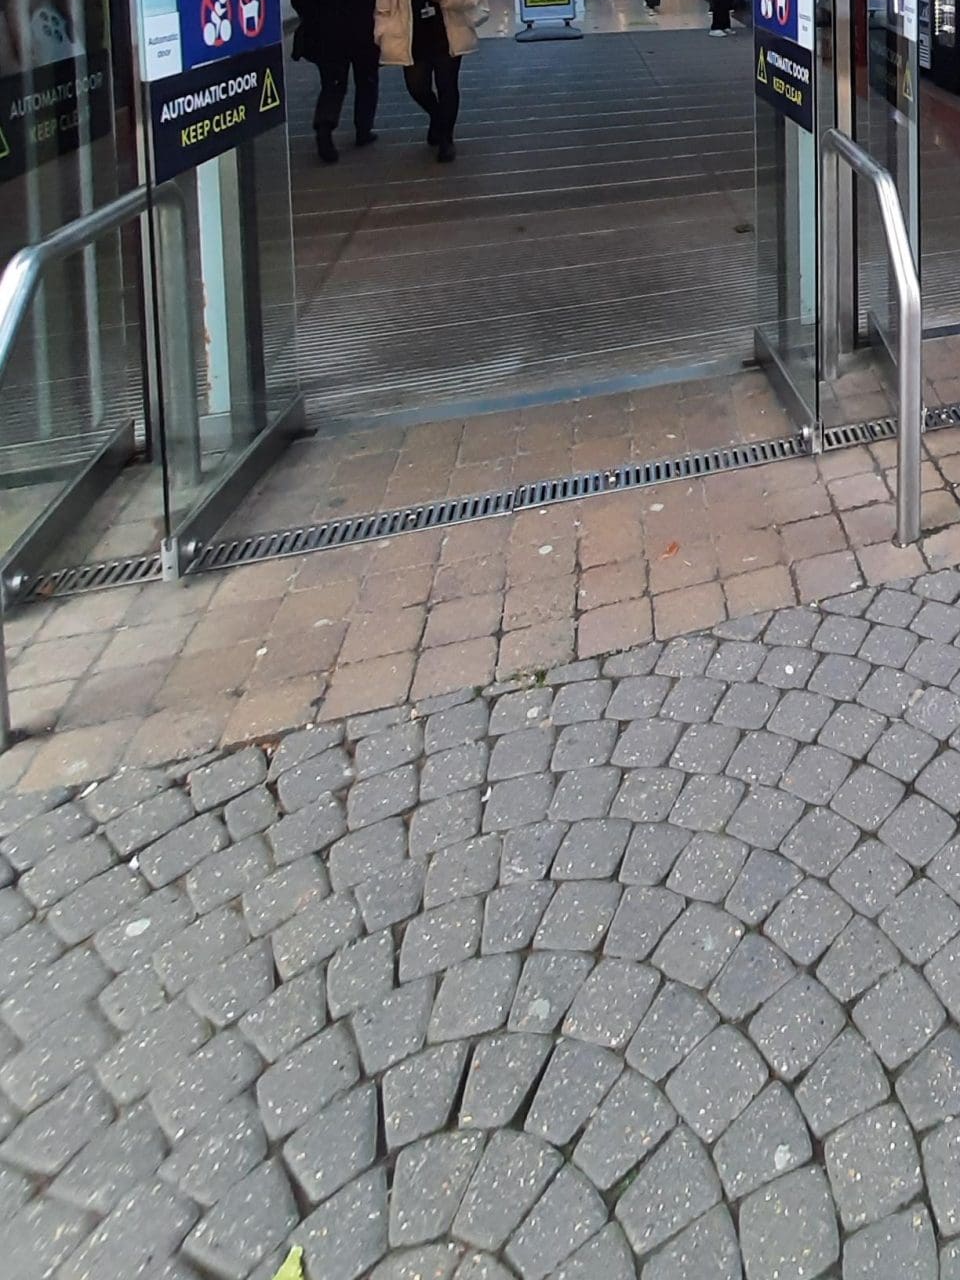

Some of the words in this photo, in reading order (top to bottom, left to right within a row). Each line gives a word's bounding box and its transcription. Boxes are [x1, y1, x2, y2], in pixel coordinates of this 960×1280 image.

[766, 50, 792, 77] AUTOMATIC
[792, 63, 810, 85] DOOR
[10, 81, 73, 120] AUTOMATIC
[160, 82, 227, 123] AUTOMATIC
[228, 71, 258, 96] DOOR
[785, 85, 803, 107] CLEAR
[181, 120, 212, 147] KEEP
[212, 105, 246, 133] CLEAR
